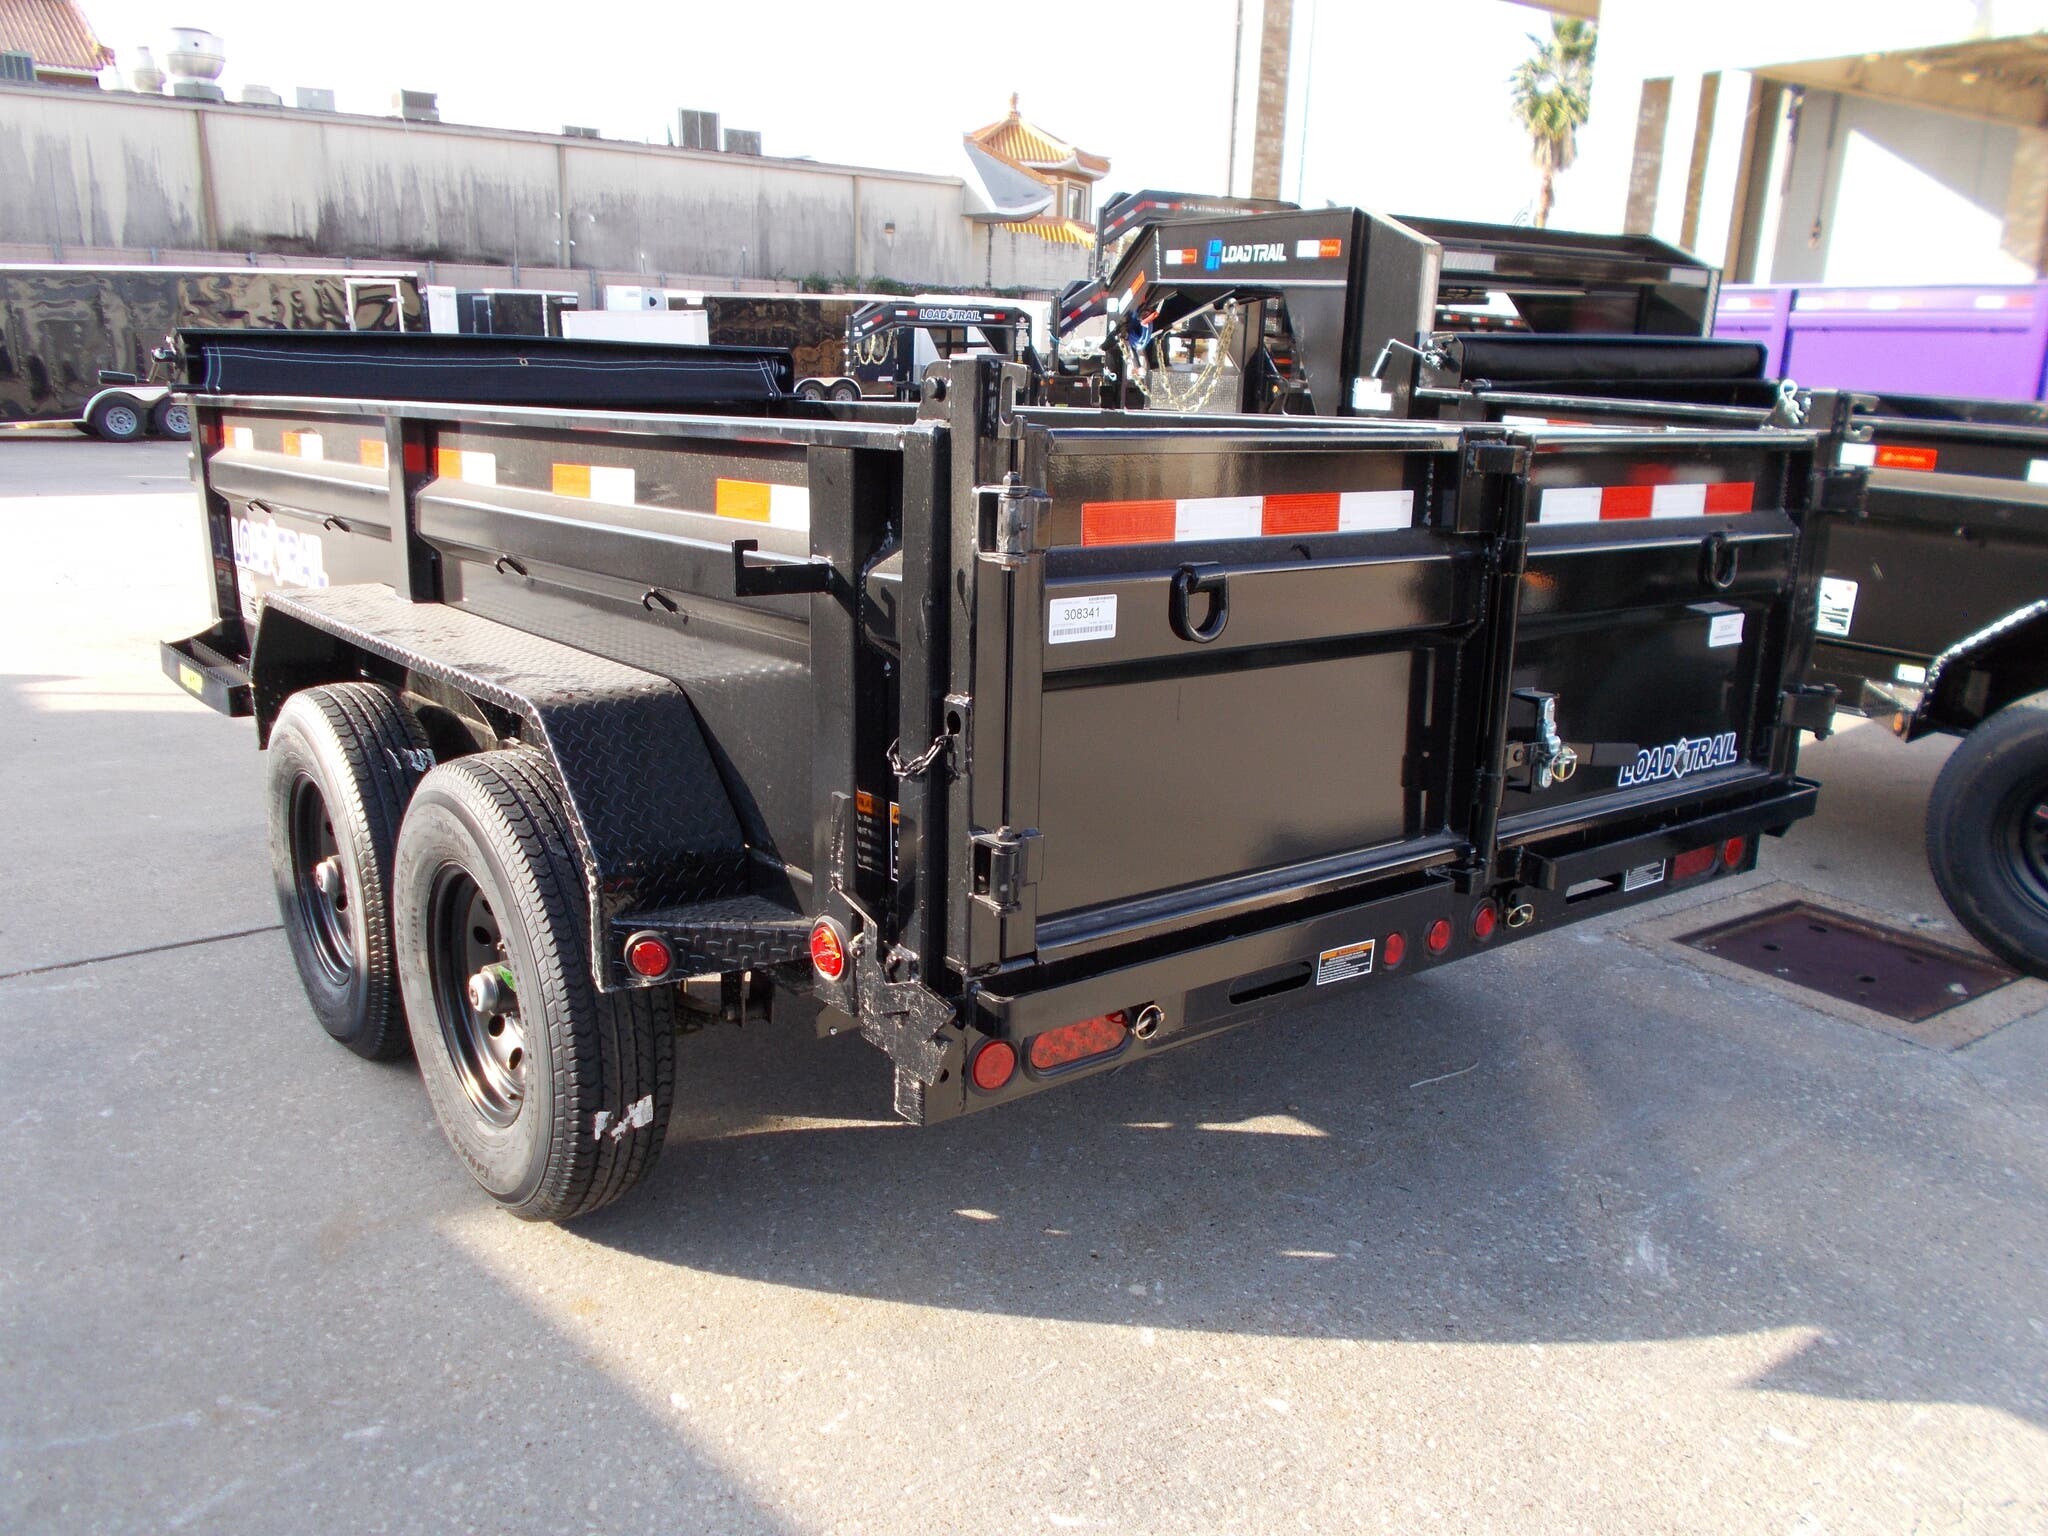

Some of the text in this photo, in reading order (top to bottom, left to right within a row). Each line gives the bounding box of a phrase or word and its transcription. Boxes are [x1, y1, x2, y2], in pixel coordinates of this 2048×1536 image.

[920, 308, 982, 322] LOAD TRAIL
[1064, 606, 1100, 621] 308341
[1618, 732, 1737, 787] LOAD TRAIL
